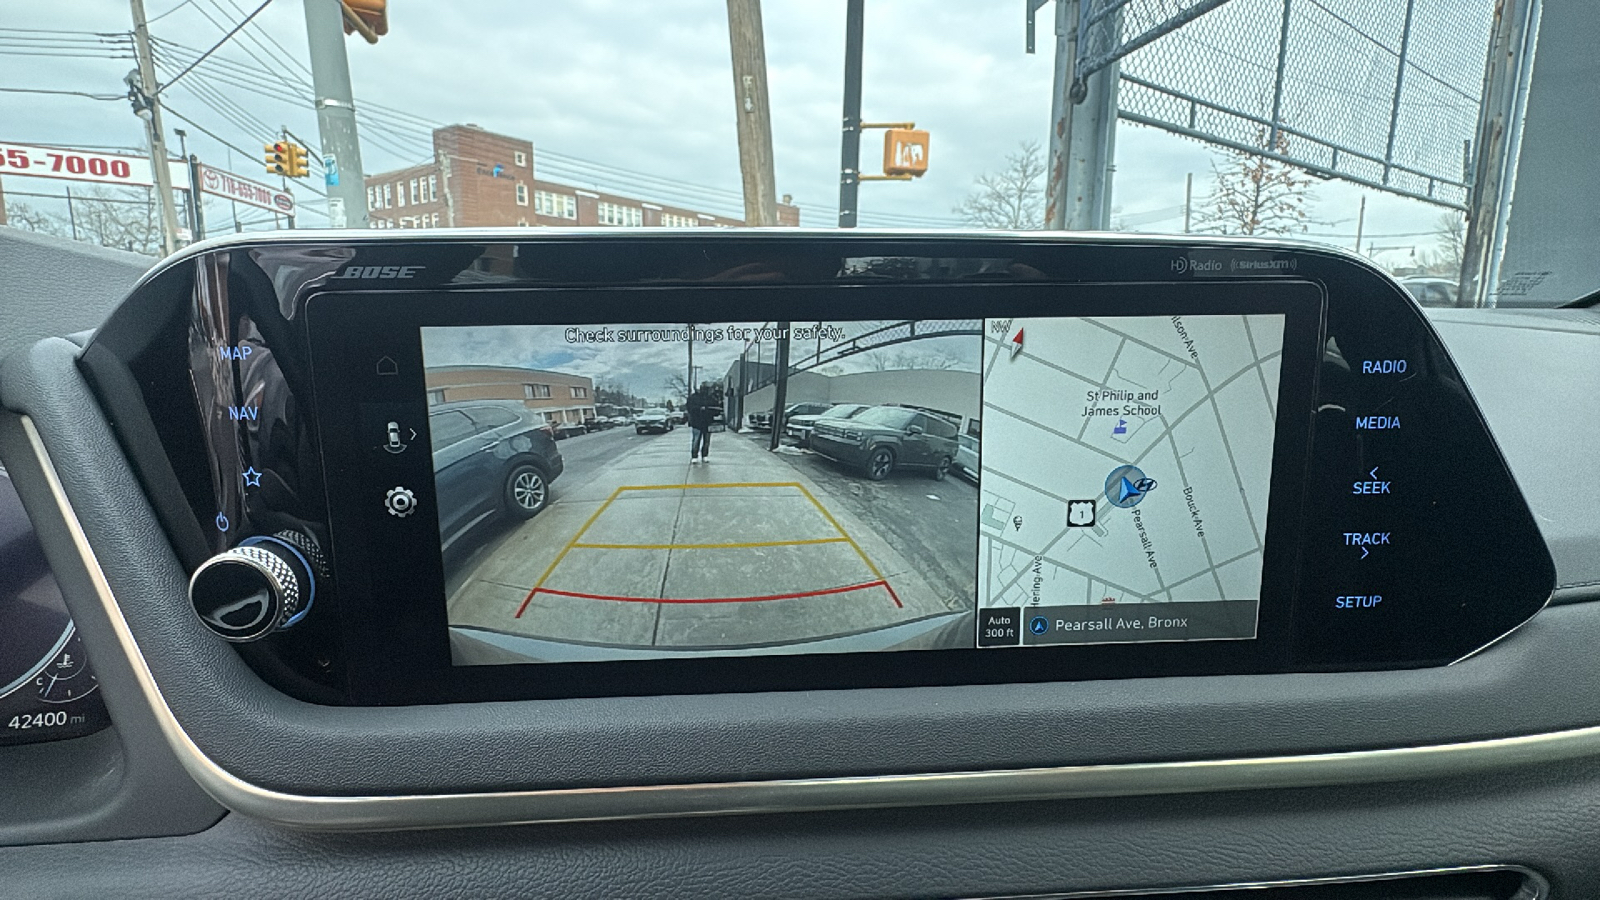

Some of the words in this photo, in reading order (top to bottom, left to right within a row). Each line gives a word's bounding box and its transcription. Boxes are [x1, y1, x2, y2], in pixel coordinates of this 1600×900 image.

[0, 148, 131, 179] 5-7000
[1189, 259, 1222, 271] Radio
[331, 266, 425, 279] BOSE
[991, 319, 1012, 333] NW
[565, 327, 615, 343] Check
[617, 326, 724, 343] surroundings
[727, 325, 751, 340] for
[754, 328, 790, 343] your
[793, 325, 846, 342] safety.
[220, 346, 252, 360] MAP
[1184, 340, 1198, 359] Ave
[1362, 360, 1407, 374] RADIO
[1086, 390, 1100, 401] St
[1102, 389, 1134, 403] Philip
[1137, 390, 1159, 400] and
[228, 406, 258, 420] NAV
[1081, 406, 1119, 417] James
[1123, 404, 1161, 416] School
[1355, 416, 1401, 430] MEDIA
[1352, 481, 1391, 495] SEEK
[1183, 486, 1200, 518] Bouck
[1192, 518, 1205, 538] Ave
[1131, 509, 1152, 549] Pearsall
[1145, 550, 1157, 569] Ave
[1343, 532, 1391, 546] TRACK
[1032, 555, 1043, 575] Ave
[1335, 595, 1383, 609] SETUP
[988, 616, 1011, 626] Auto
[1055, 618, 1113, 631] Pearsall
[1148, 616, 1188, 629] Bronx
[985, 628, 1004, 638] 300
[1006, 628, 1014, 637] ft
[36, 677, 44, 686] C
[8, 711, 68, 729] 42400
[70, 713, 86, 725] mi
